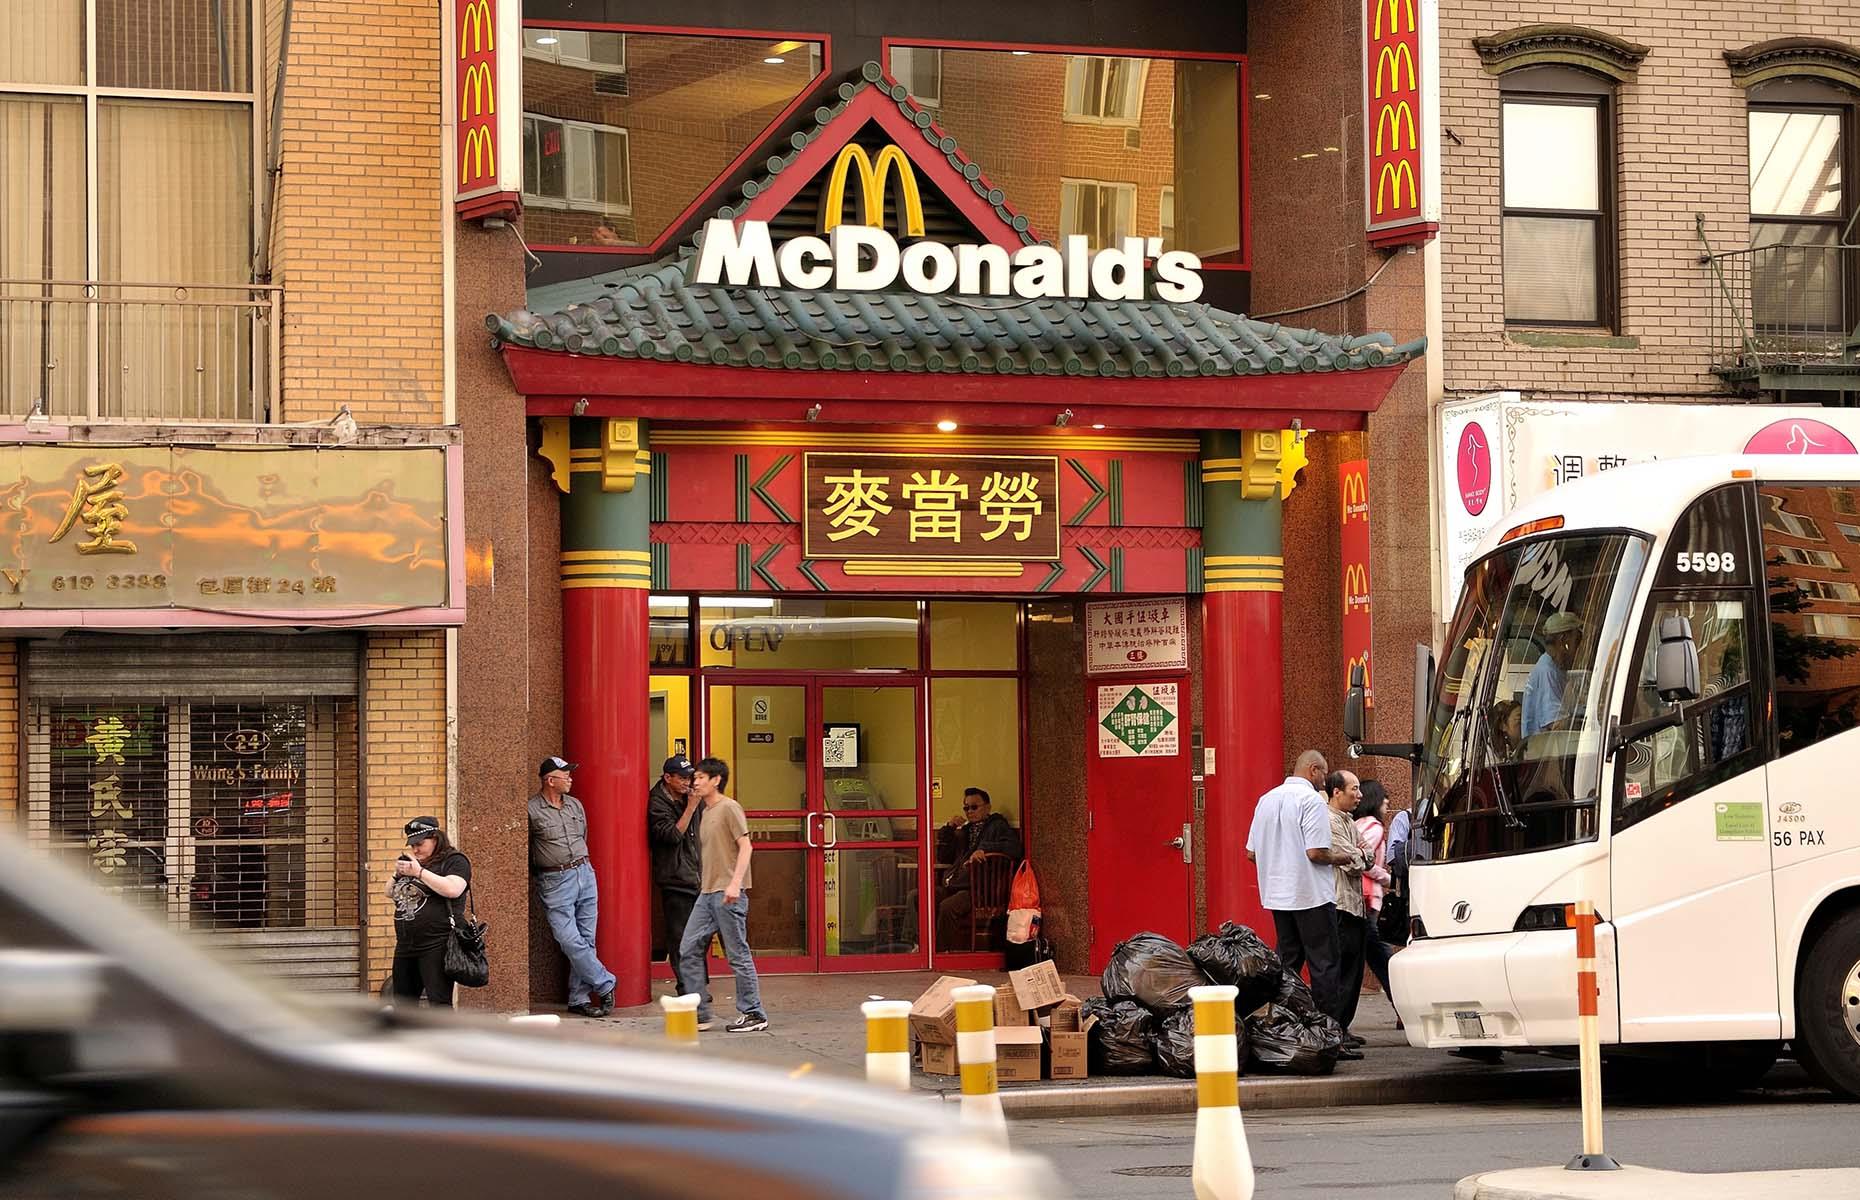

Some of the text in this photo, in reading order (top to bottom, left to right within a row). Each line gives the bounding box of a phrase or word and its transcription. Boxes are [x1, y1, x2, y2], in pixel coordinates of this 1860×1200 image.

[695, 218, 1204, 303] McDonald's
[822, 469, 1043, 543] 麥當勞
[1676, 552, 1736, 573] 5598
[235, 734, 260, 750] 24
[254, 761, 300, 784] Family
[1773, 830, 1825, 847] 56 PAX
